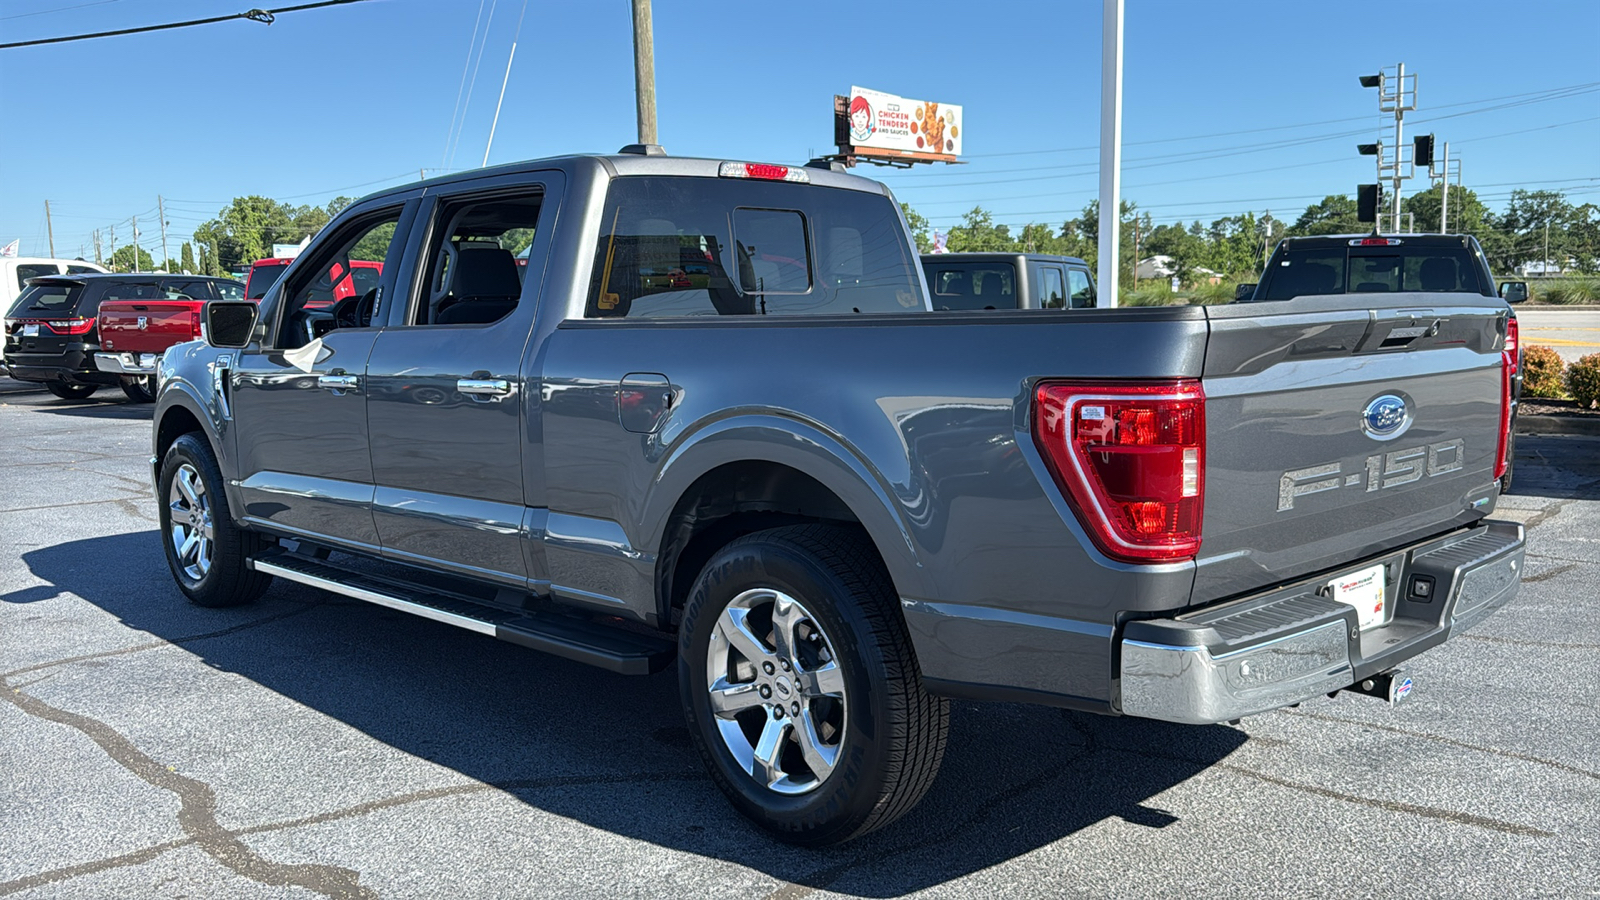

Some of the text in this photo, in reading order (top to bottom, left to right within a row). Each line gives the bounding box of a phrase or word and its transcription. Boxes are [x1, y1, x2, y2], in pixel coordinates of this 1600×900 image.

[878, 110, 909, 120] CHICKEN
[878, 119, 909, 129] TENDERS
[890, 128, 909, 136] SAUCES
[1377, 404, 1403, 427] Ford
[1276, 437, 1465, 513] F-150
